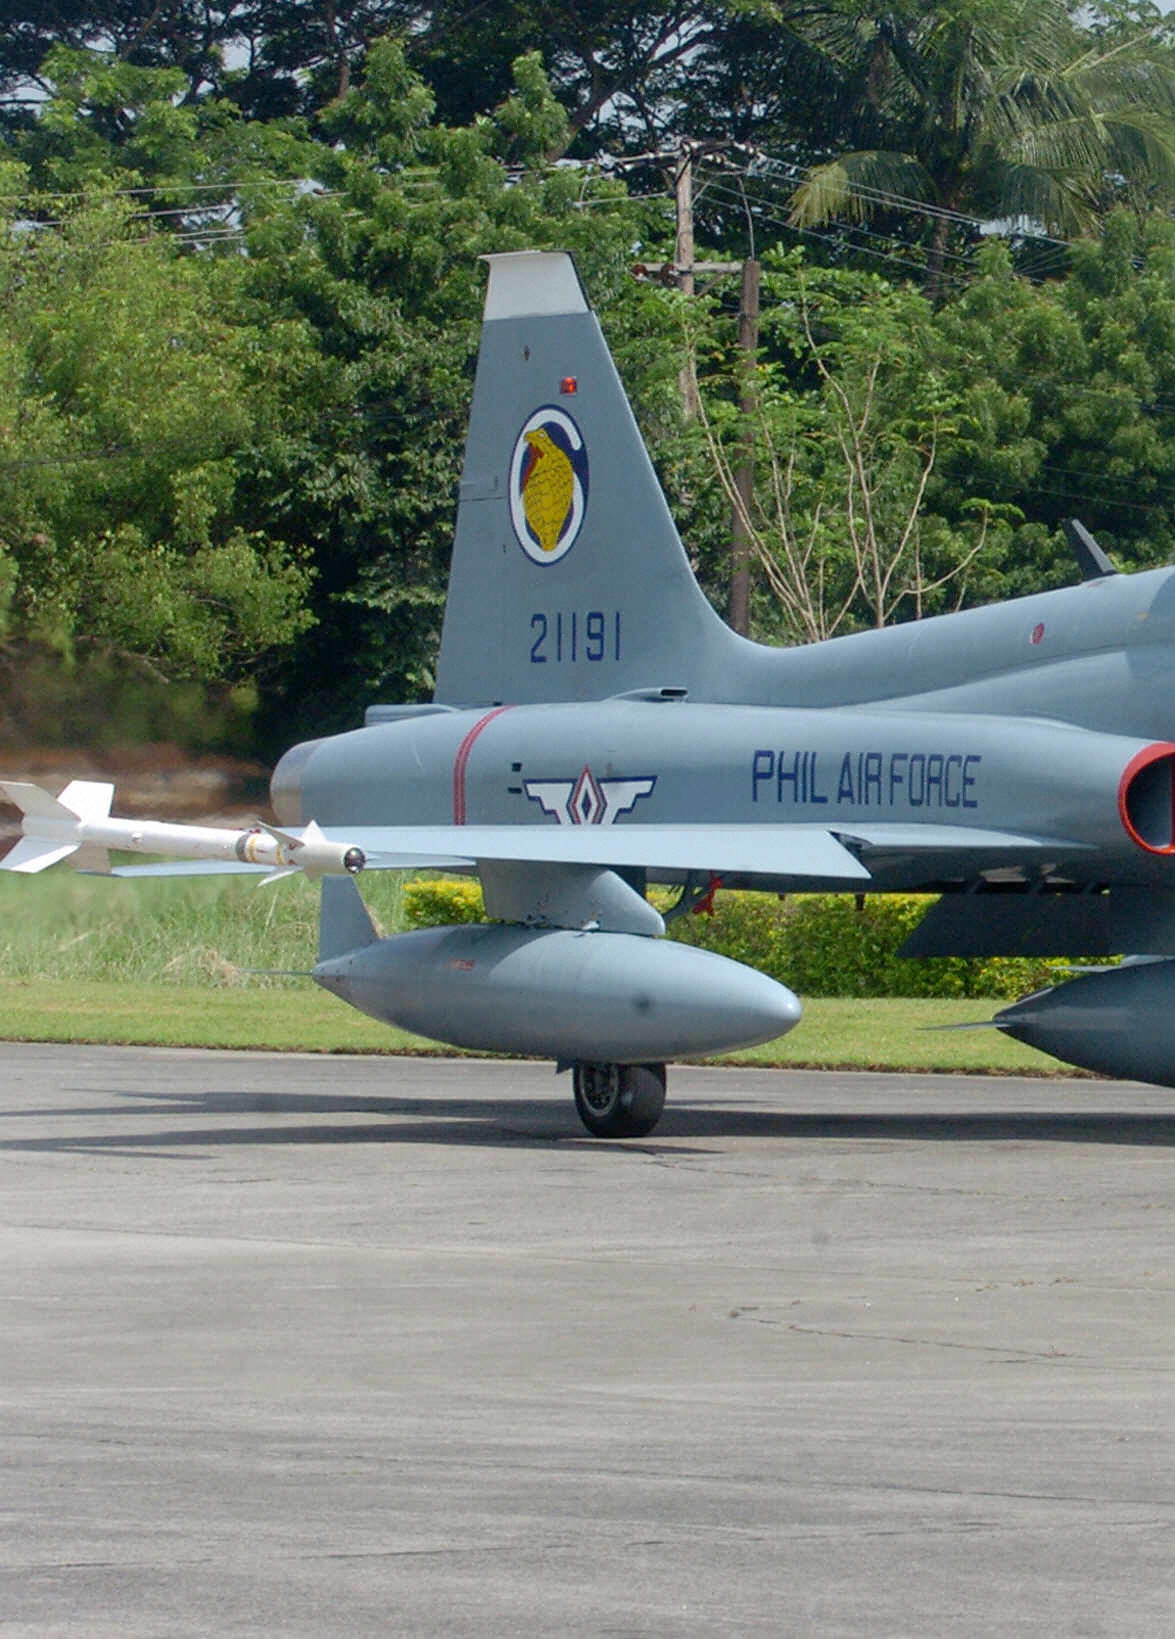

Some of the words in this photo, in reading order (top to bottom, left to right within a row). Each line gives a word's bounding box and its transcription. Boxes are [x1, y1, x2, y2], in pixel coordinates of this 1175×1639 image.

[530, 611, 620, 663] 21191
[752, 750, 828, 804] PHIL
[836, 751, 882, 806] AIR
[889, 753, 982, 808] FORCE
